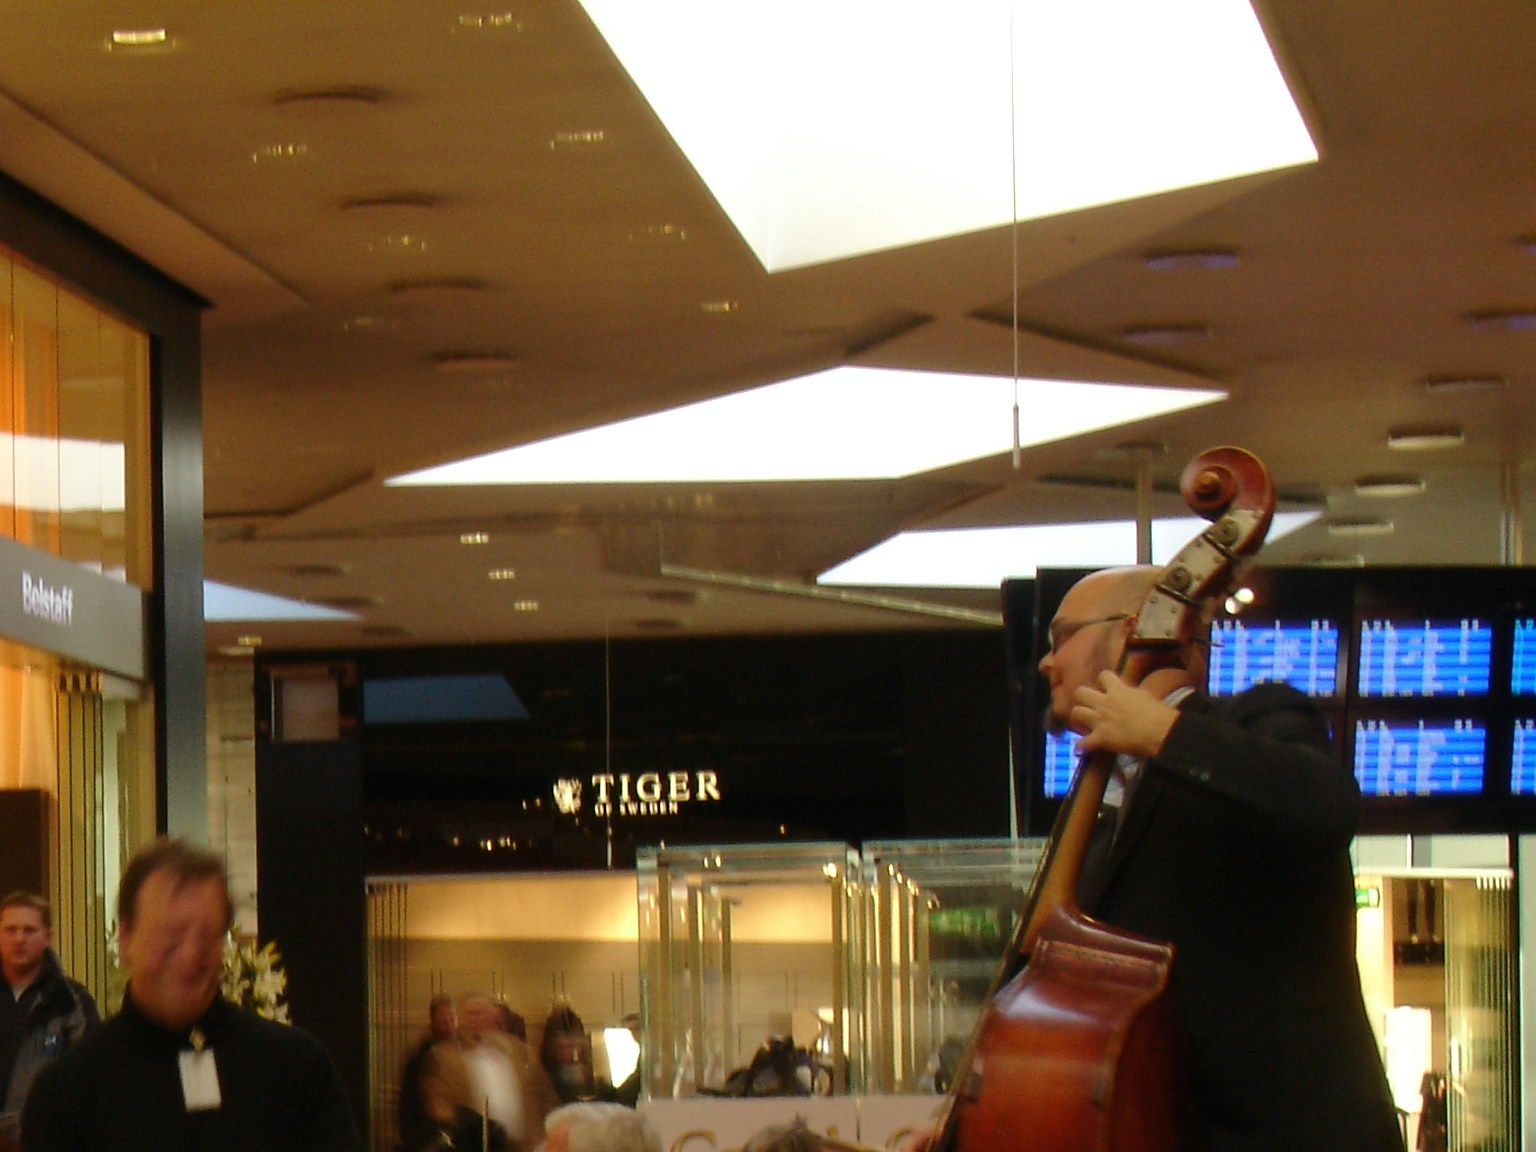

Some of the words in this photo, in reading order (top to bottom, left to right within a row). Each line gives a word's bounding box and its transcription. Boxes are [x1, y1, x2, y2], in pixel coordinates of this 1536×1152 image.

[22, 571, 72, 626] Belstaff
[591, 771, 721, 803] TIGER
[595, 801, 613, 817] OF
[620, 800, 678, 816] SWEDEN
